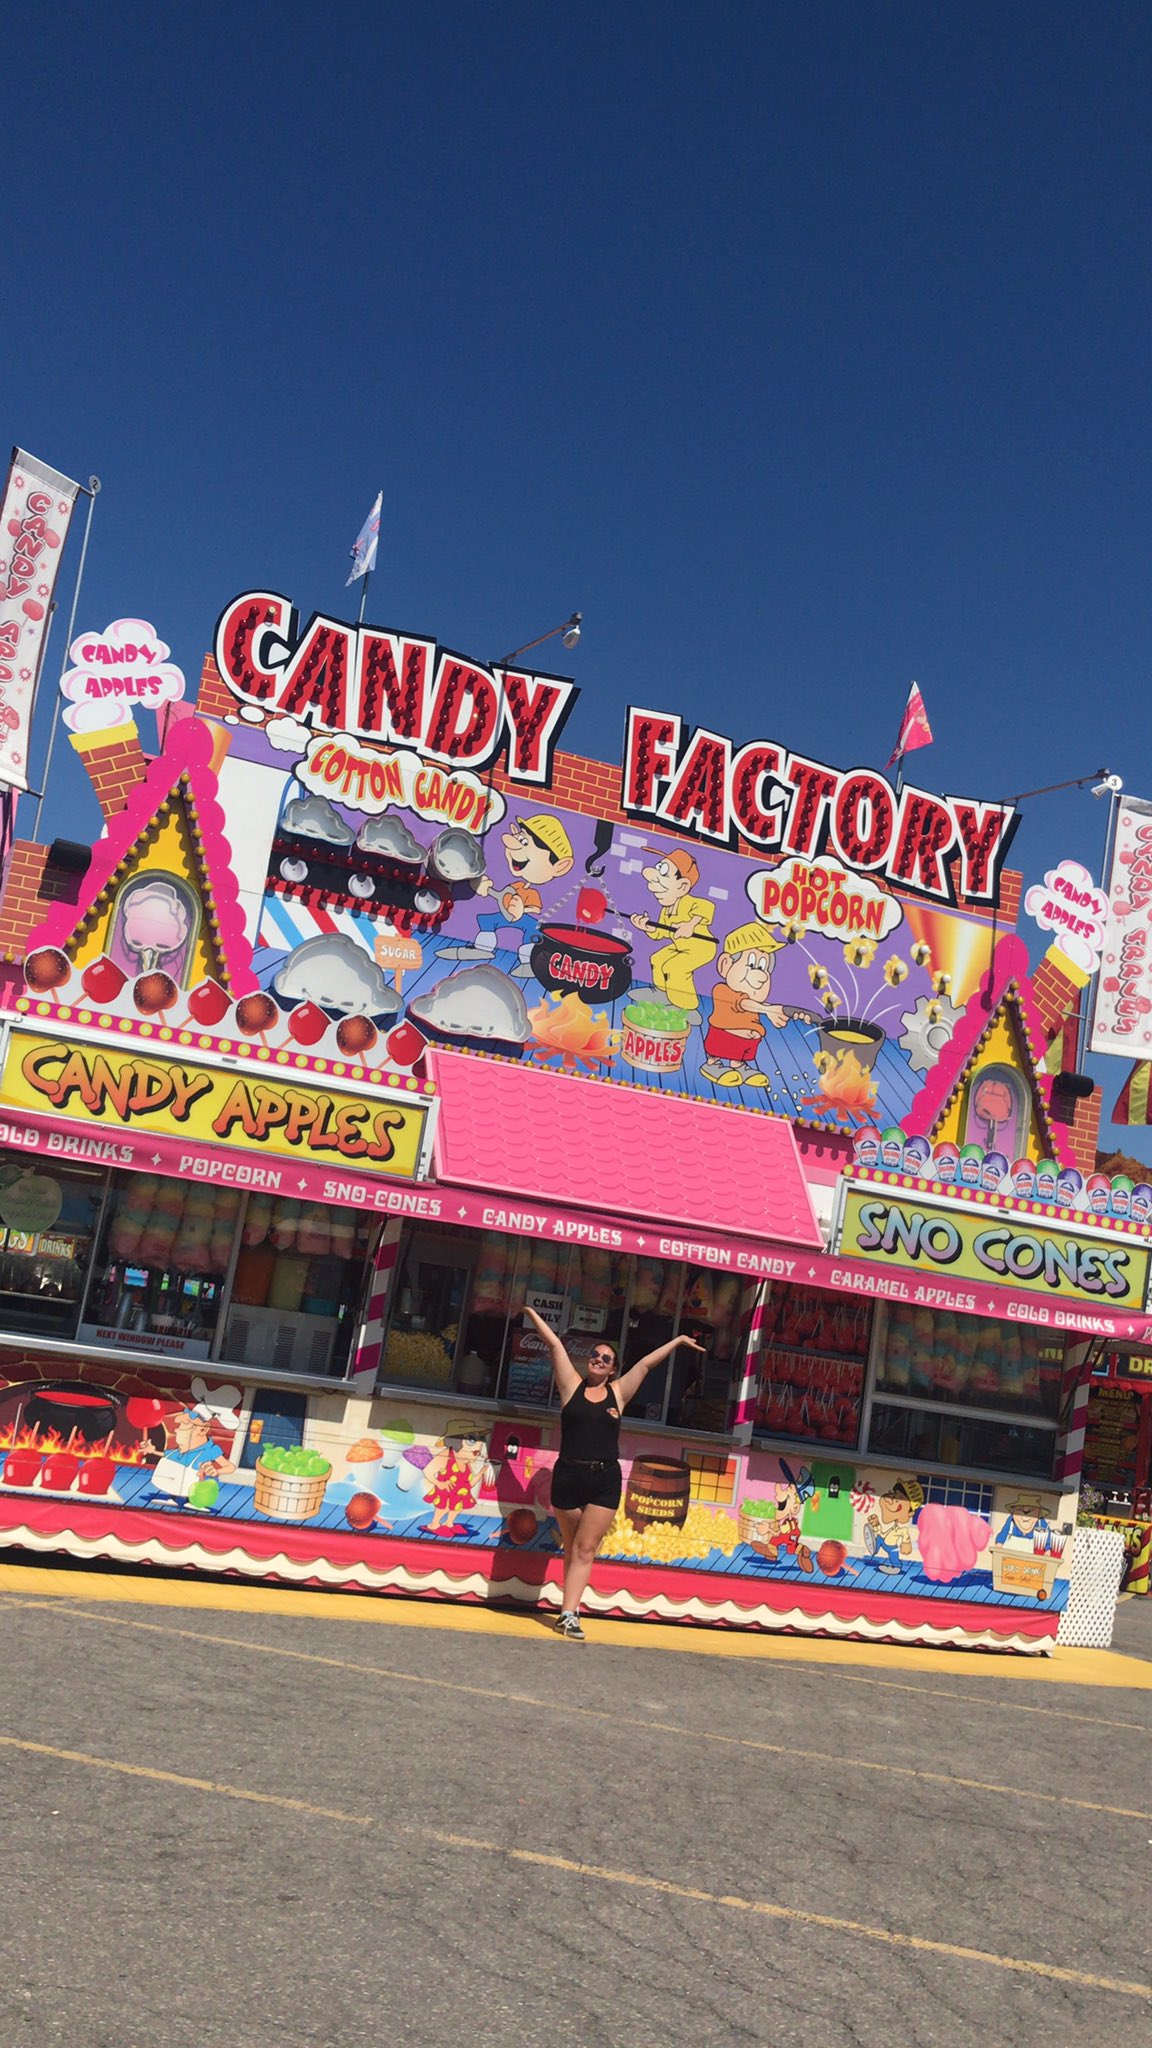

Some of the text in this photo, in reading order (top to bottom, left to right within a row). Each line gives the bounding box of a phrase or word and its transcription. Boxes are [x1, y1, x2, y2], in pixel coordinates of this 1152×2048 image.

[6, 491, 53, 599] CANDY
[81, 643, 157, 665] CANDY
[84, 675, 164, 698] APPLES
[214, 588, 1022, 906] CANDY FACTORY
[308, 742, 495, 831] COTTON CANDY
[791, 861, 847, 892] HOT
[762, 877, 886, 939] POPCORN
[1053, 876, 1103, 917] CANDY
[1040, 900, 1096, 941] APPLES
[380, 944, 416, 961] SUGAR
[548, 952, 615, 991] CANDY
[1111, 928, 1149, 1036] APPLES
[624, 1030, 683, 1063] APPLES
[21, 1042, 406, 1162] CANDY APPLES
[46, 1132, 136, 1164] DRINKS
[178, 1154, 283, 1189] POPCORN
[323, 1179, 443, 1218] SNO-CONES
[482, 1207, 623, 1247] CANDY APPLES
[41, 1238, 73, 1258] DRINKS
[659, 1237, 797, 1277] COTTON CANDY
[856, 1201, 1131, 1299] SNO CONES
[532, 1298, 564, 1311] CASH
[829, 1269, 977, 1311] CARAMEL APPLES
[536, 1311, 562, 1323] NLY
[1006, 1302, 1050, 1323] COLD
[1054, 1310, 1117, 1334] DRINKS
[95, 1328, 186, 1350] NEXT WINDOW PLEASE
[630, 1492, 685, 1508] POPCORN
[635, 1505, 676, 1518] SEEDS
